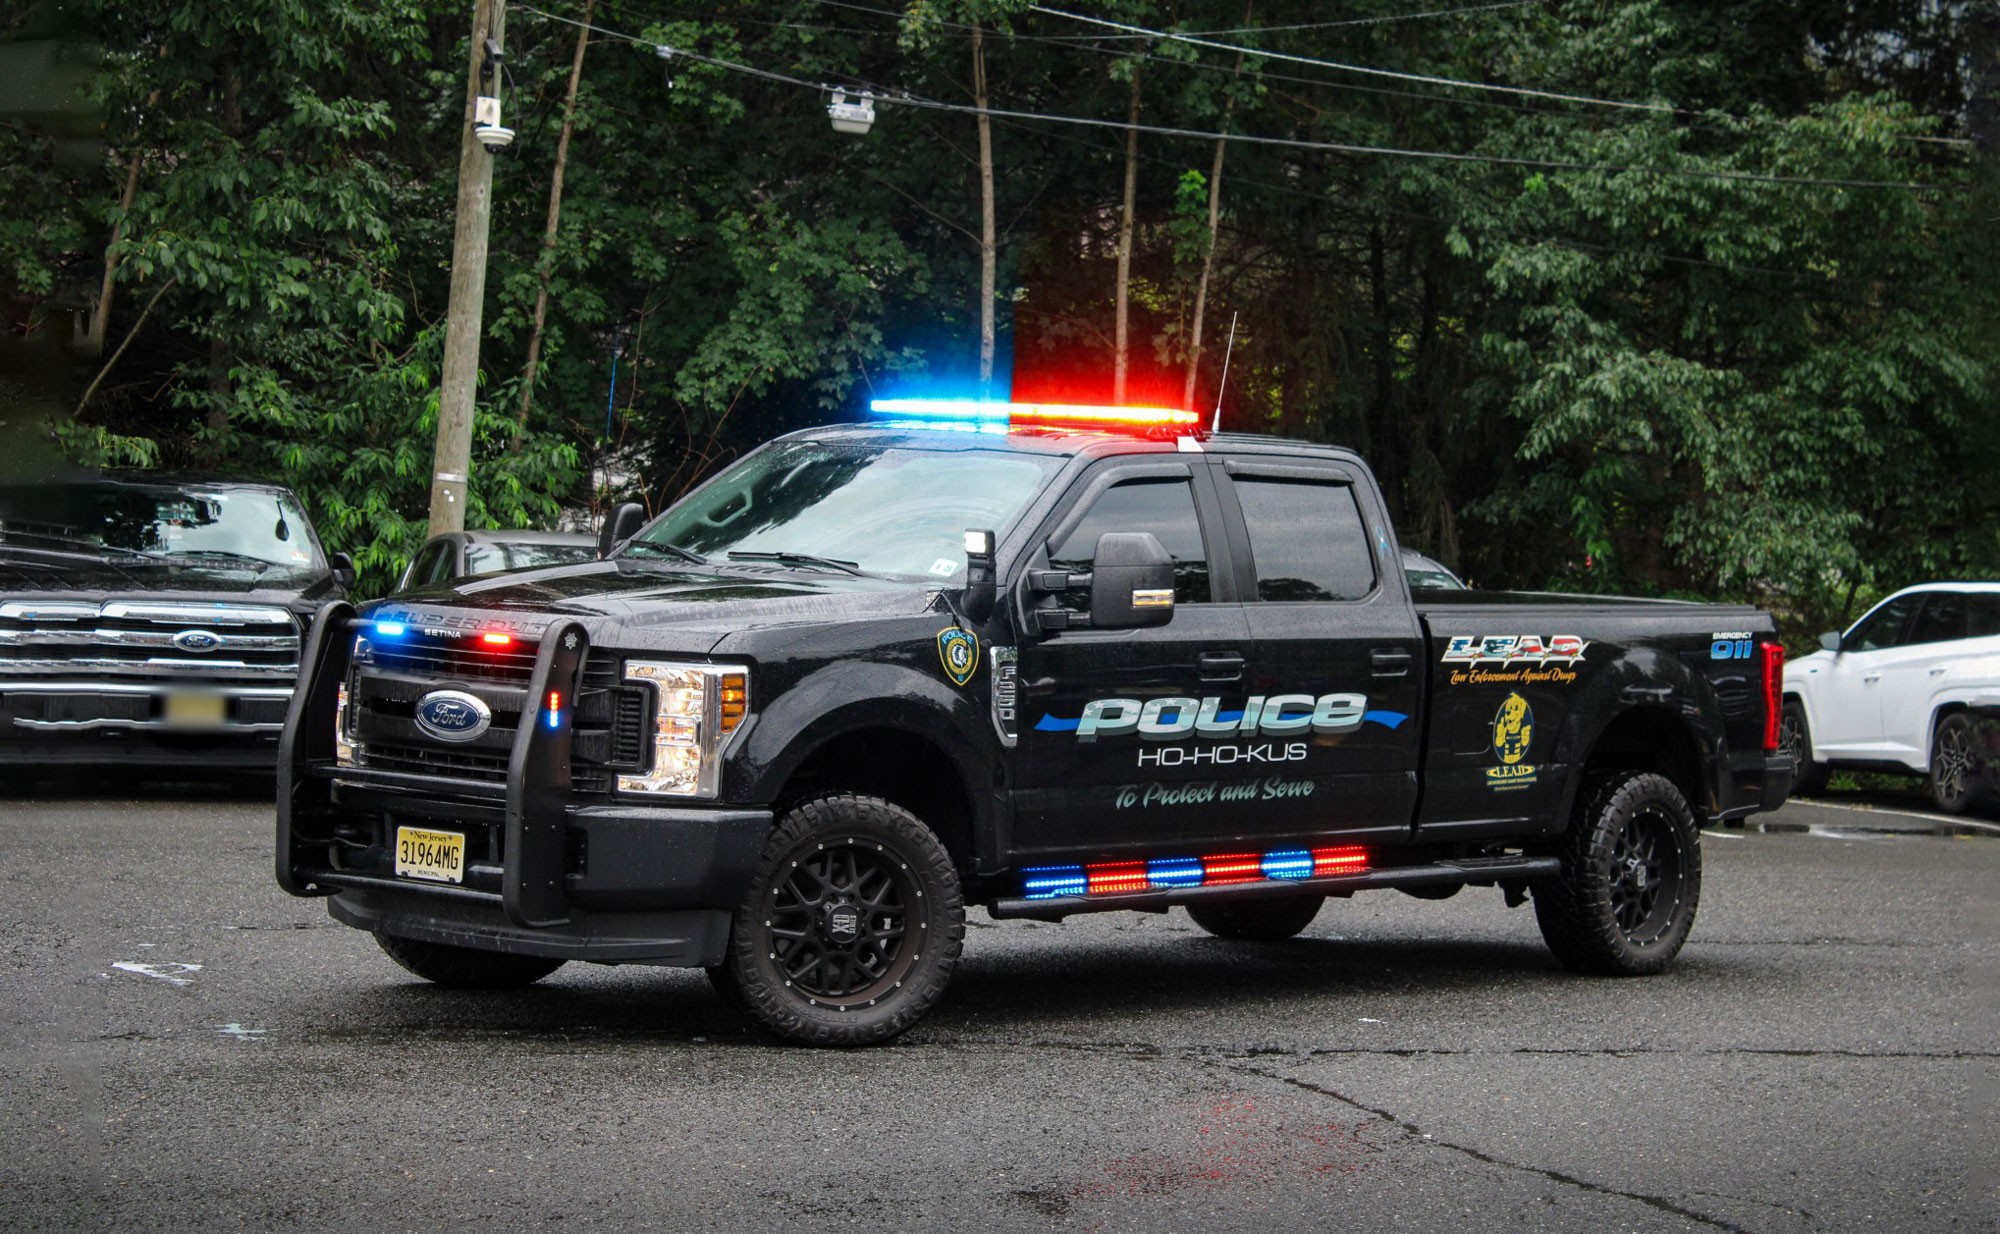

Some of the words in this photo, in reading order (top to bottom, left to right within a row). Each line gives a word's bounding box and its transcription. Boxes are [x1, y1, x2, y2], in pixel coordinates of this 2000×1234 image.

[424, 628, 461, 639] SETINA
[942, 630, 974, 645] POLICE
[1712, 631, 1752, 640] EMERGENCY
[1711, 640, 1753, 660] 911
[1450, 669, 1468, 685] Law
[1469, 668, 1520, 684] Enforcement
[1520, 667, 1552, 685] Against
[1552, 666, 1577, 684] Drugs
[432, 703, 467, 726] Ford
[1137, 743, 1307, 767] HO-HO-KUS
[1115, 784, 1138, 810] To
[1143, 781, 1219, 808] Protect
[1220, 778, 1260, 801] and
[1262, 776, 1316, 800] Serve
[413, 831, 428, 840] New
[428, 833, 447, 842] Jersey
[400, 840, 459, 870] 31964MG
